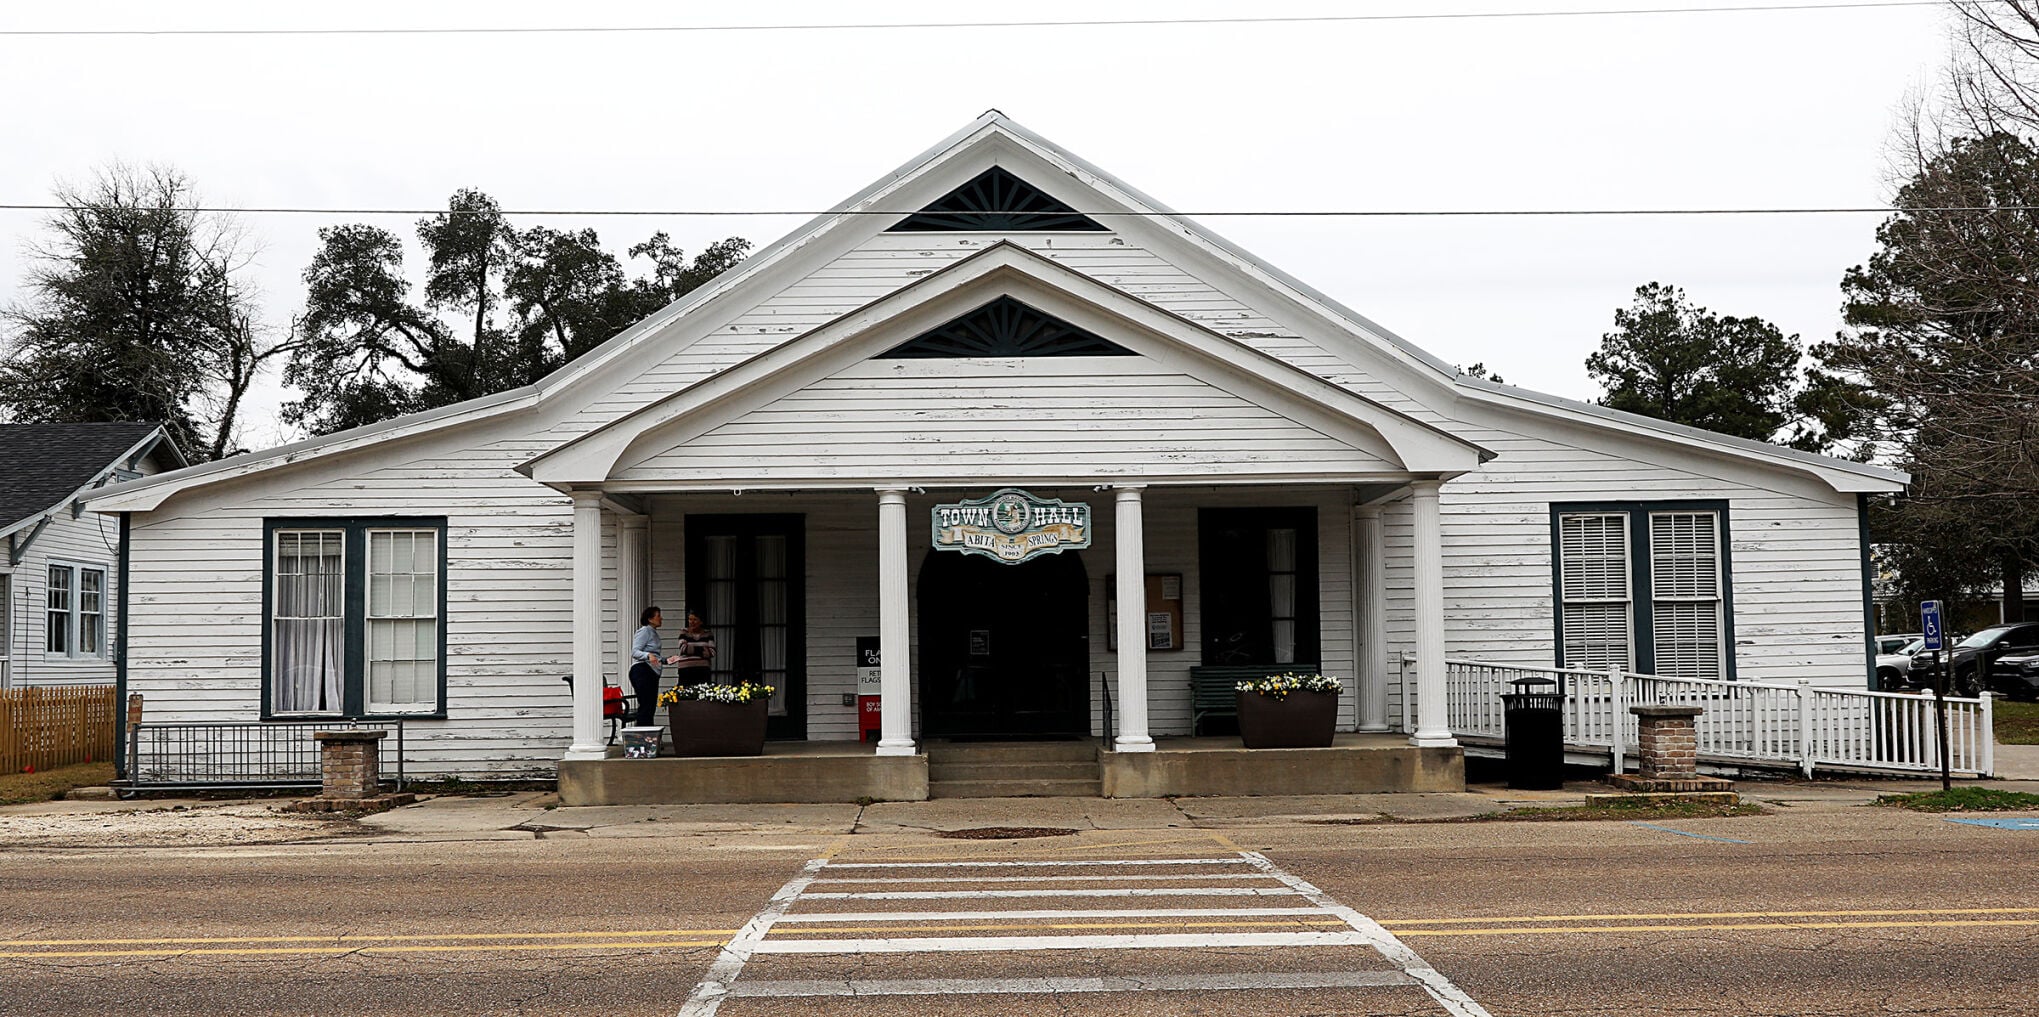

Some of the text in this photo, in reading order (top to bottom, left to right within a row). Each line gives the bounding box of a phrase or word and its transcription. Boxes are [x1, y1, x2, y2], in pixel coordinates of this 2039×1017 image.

[941, 508, 989, 527] TOWN
[1034, 507, 1083, 526] HALL
[967, 534, 1058, 548] ABITA SPRINGS
